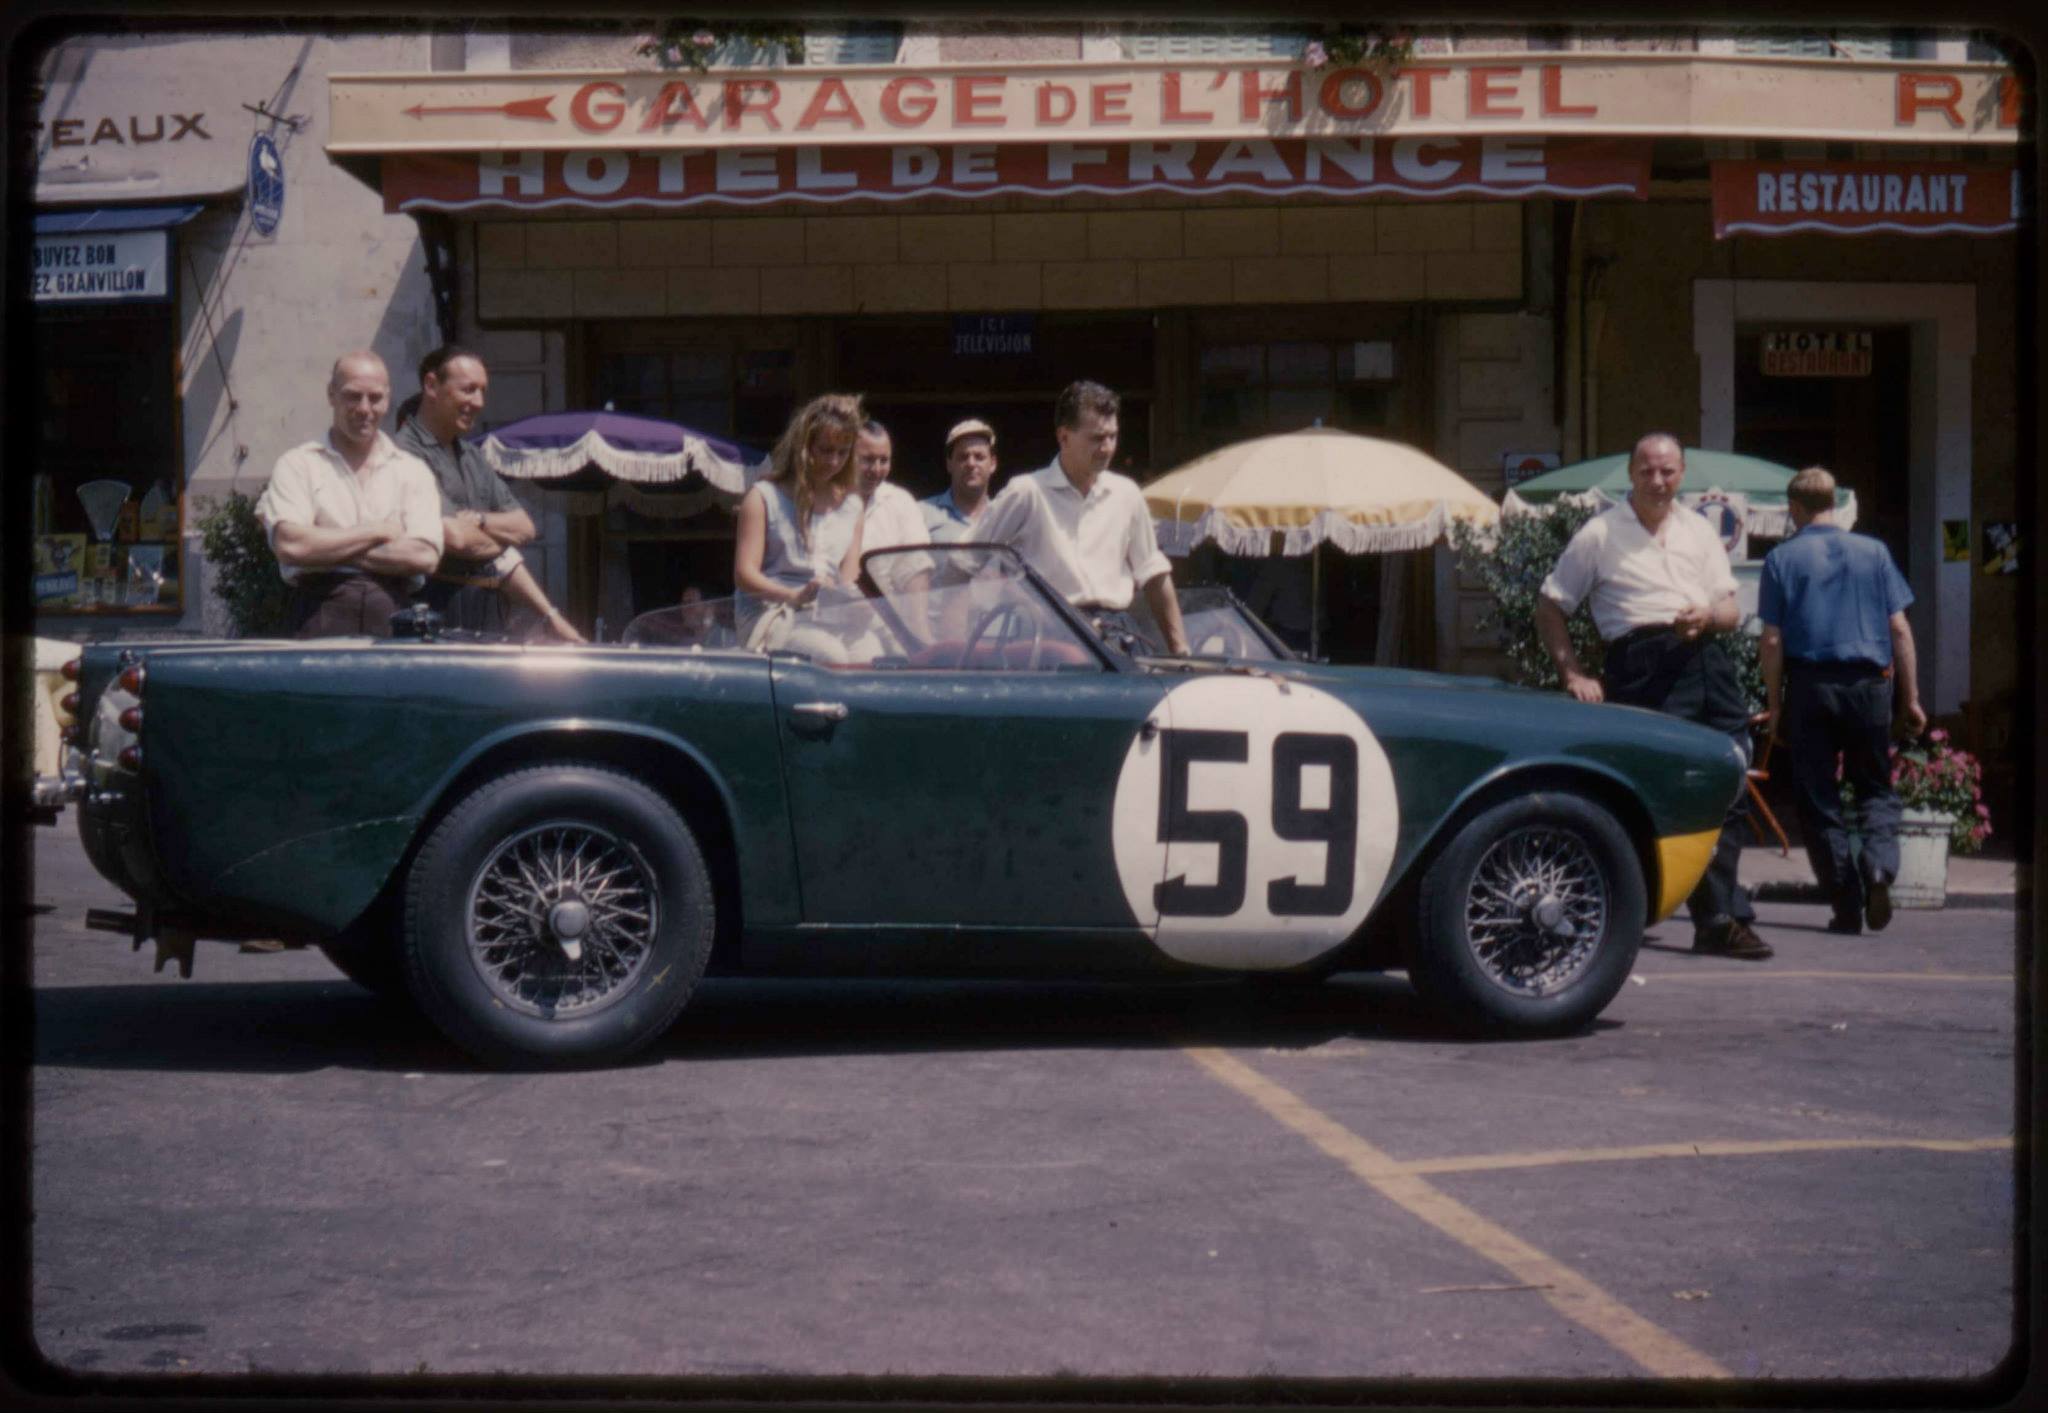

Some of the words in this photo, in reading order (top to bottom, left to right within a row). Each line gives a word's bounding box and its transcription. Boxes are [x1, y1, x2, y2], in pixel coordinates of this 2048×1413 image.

[569, 76, 1007, 134] GARAGE
[1035, 81, 1132, 126] DE
[33, 113, 212, 148] EAUX
[478, 148, 858, 196] HOTEL
[891, 144, 998, 187] DE
[1046, 138, 1548, 182] FRANCE
[1757, 172, 1967, 213] RESTAURANT
[86, 244, 115, 265] BON
[56, 268, 145, 293] GRANVILLON
[1774, 332, 1871, 351] HOTEL
[1153, 727, 1358, 918] 59
